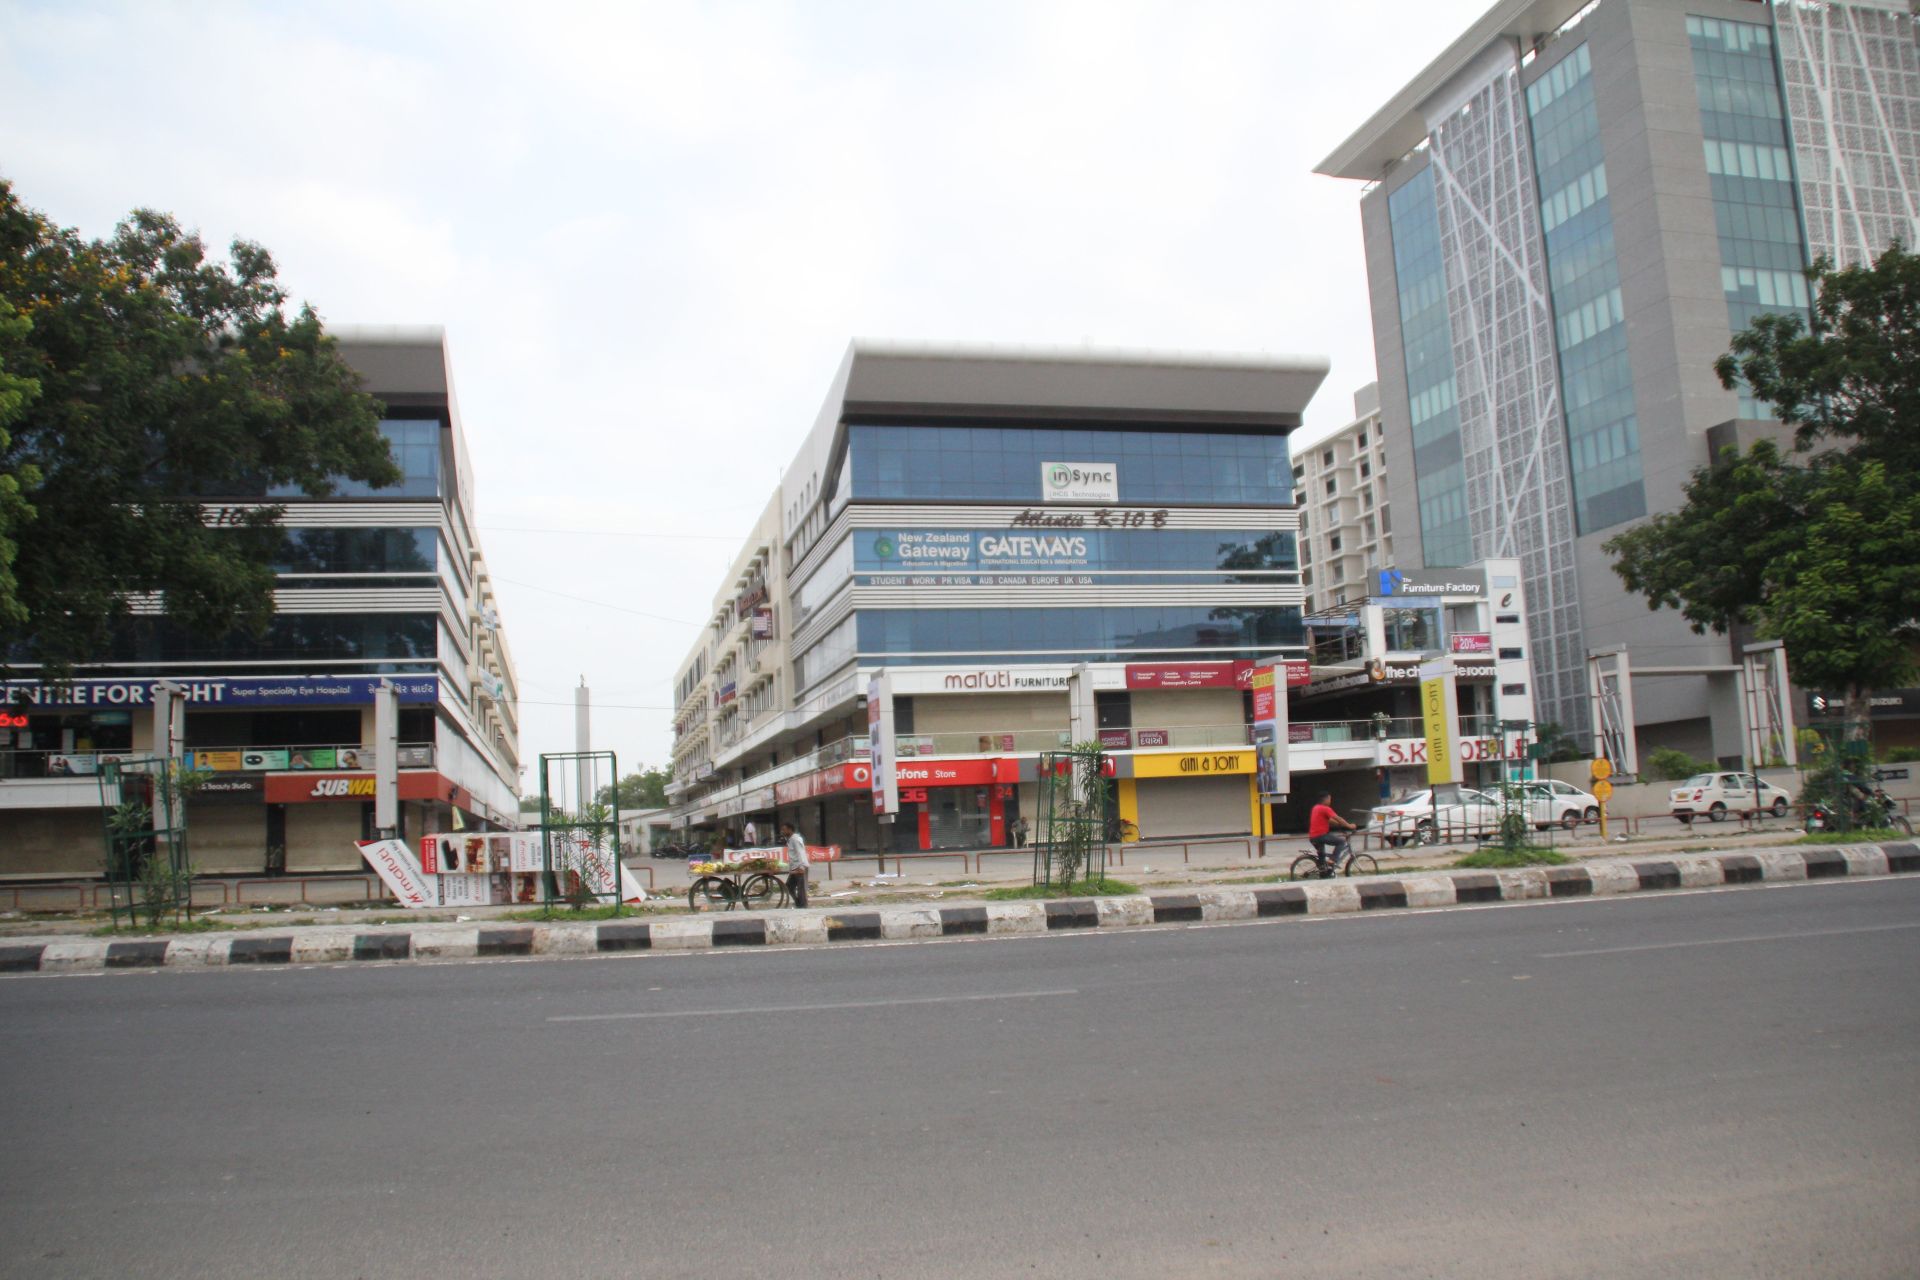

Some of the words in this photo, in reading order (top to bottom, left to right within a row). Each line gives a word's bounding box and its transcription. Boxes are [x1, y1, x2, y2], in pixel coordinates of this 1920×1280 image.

[898, 533, 922, 542] New
[925, 533, 969, 543] Zealand
[898, 543, 969, 560] Gateway
[979, 536, 1086, 556] GATEWAYS
[870, 577, 906, 585] STUDENT
[912, 577, 936, 585] WORK
[941, 577, 952, 585] PR
[954, 577, 971, 585] VISA
[979, 577, 993, 585] AUS
[998, 577, 1027, 585] CANADA
[1031, 577, 1059, 585] EUROPE
[1064, 577, 1074, 585] UK
[1078, 577, 1092, 585] USA
[1402, 583, 1445, 592] Furniture
[1446, 583, 1480, 593] Factory
[945, 670, 1011, 689] maruti
[0, 685, 87, 704] ENTRE
[93, 685, 144, 704] FOR
[150, 683, 225, 703] SGHT
[232, 687, 256, 697] Super
[299, 686, 314, 696] Eye
[316, 685, 350, 696] Hospital
[935, 770, 956, 779] Store
[311, 779, 376, 797] SUBWA
